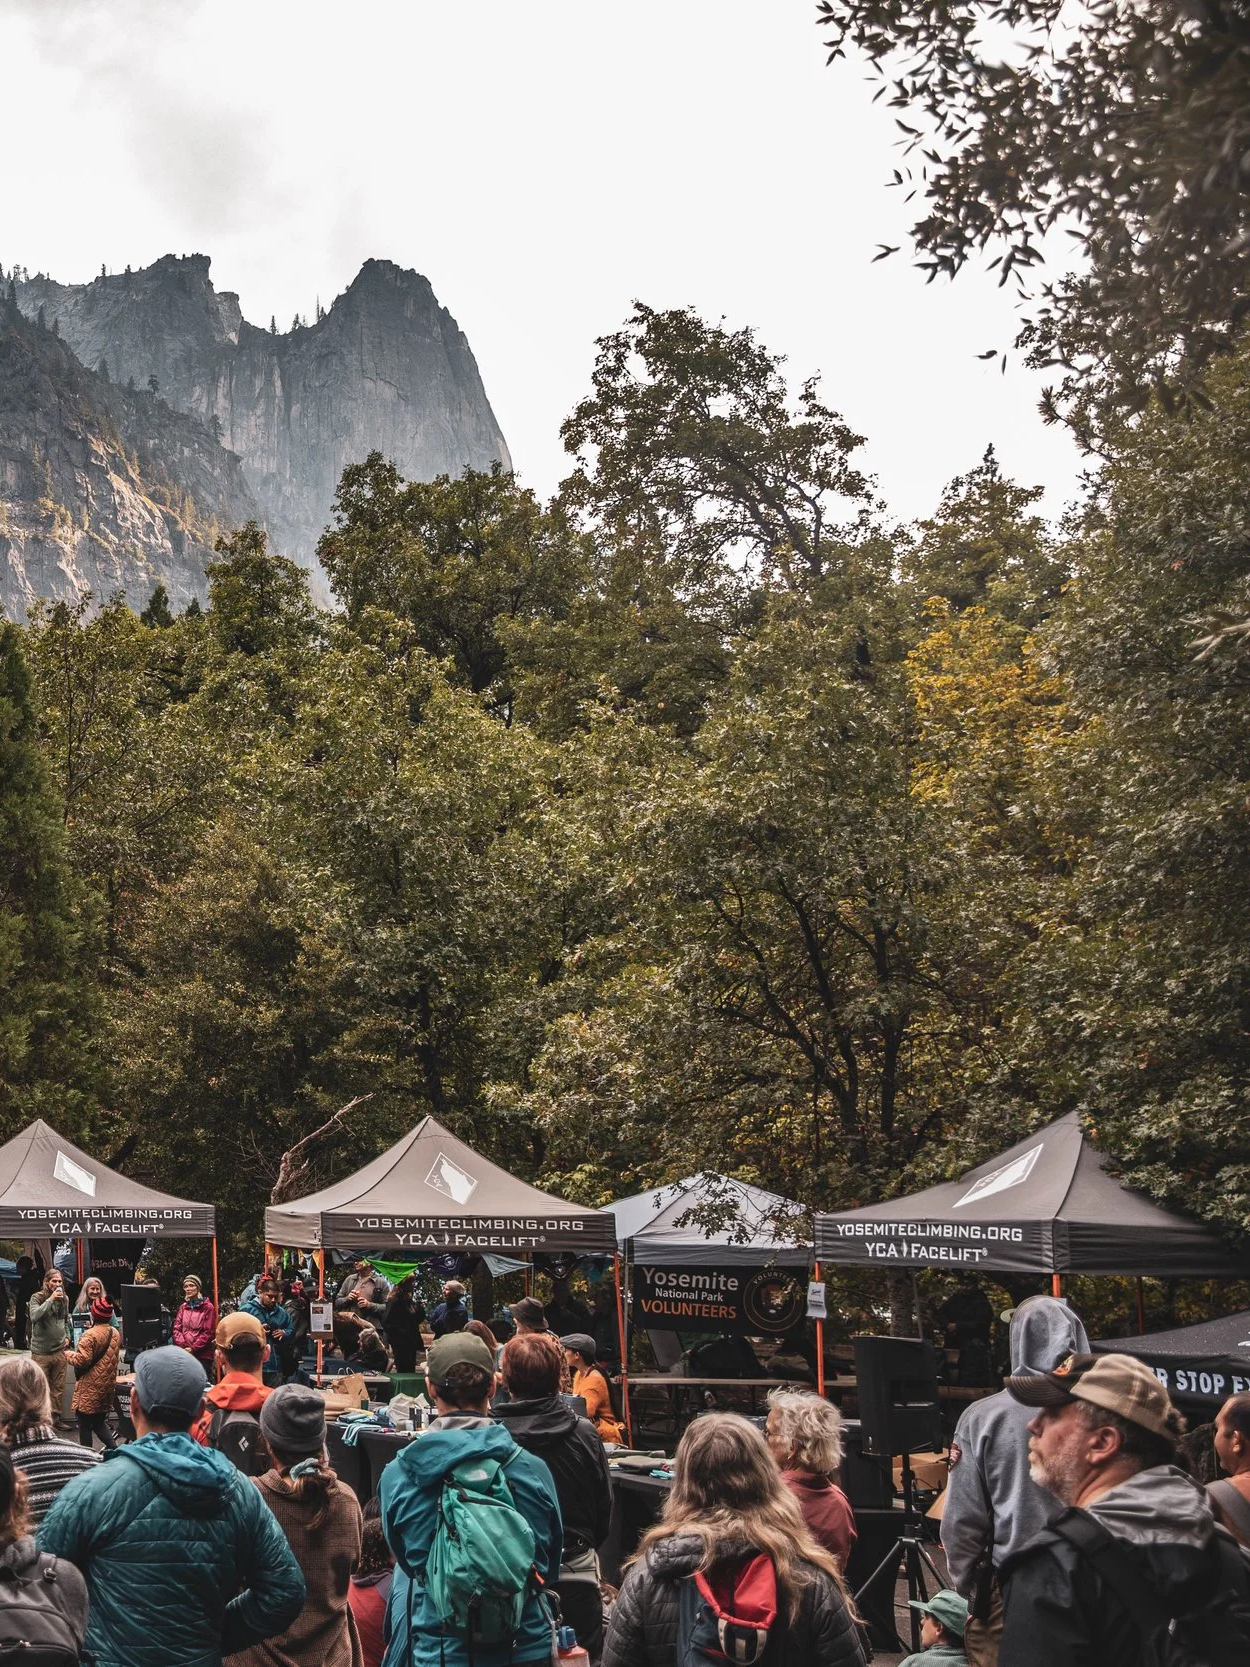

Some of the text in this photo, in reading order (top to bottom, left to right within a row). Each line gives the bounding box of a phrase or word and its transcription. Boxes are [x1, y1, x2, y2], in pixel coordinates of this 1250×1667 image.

[18, 1209, 193, 1219] YOSEMITECLIMBING.ORG
[49, 1222, 82, 1234] YCA
[355, 1218, 584, 1231] YOSEMITECLIMBING.ORG
[395, 1233, 438, 1246] YCA
[836, 1223, 1023, 1242] YOSEMITECLIMBING.ORG
[865, 1242, 899, 1258] YCA
[642, 1266, 739, 1291] Yosemite
[752, 1271, 794, 1285] VOLUNTEE
[655, 1287, 724, 1302] National Park
[641, 1299, 737, 1319] VOLUNTEERS
[1175, 1369, 1225, 1395] STOP
